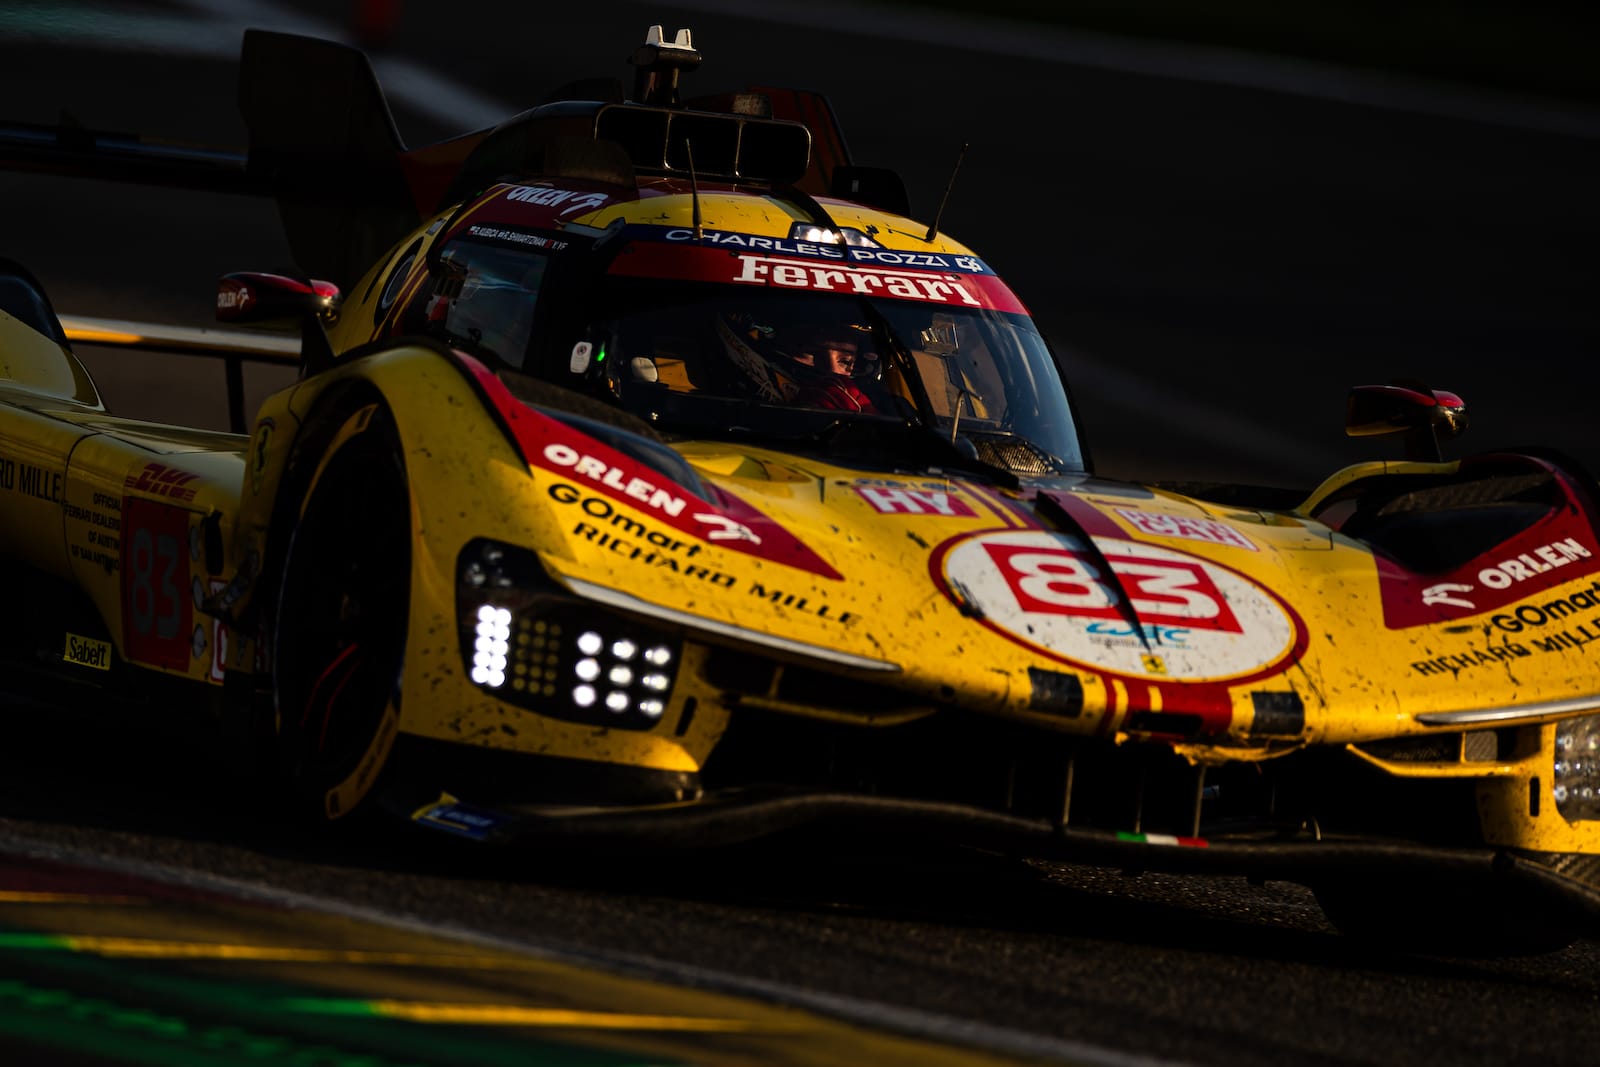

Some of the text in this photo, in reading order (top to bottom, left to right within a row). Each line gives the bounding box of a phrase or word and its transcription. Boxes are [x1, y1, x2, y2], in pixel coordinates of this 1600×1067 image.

[507, 186, 578, 207] ORLEN
[665, 228, 846, 259] CHARLES
[852, 247, 951, 268] POZZI
[732, 254, 982, 307] Ferrari
[19, 463, 61, 503] MILLE
[542, 442, 688, 519] ORLEN
[859, 487, 955, 515] HY
[548, 483, 701, 557] GOmart
[129, 527, 185, 641] 83
[573, 522, 862, 625] RICHARD MILLE
[1007, 551, 1222, 620] 83
[1477, 536, 1593, 590] ORLEN
[70, 636, 106, 667] Sabelt
[1411, 641, 1532, 677] RICHARD
